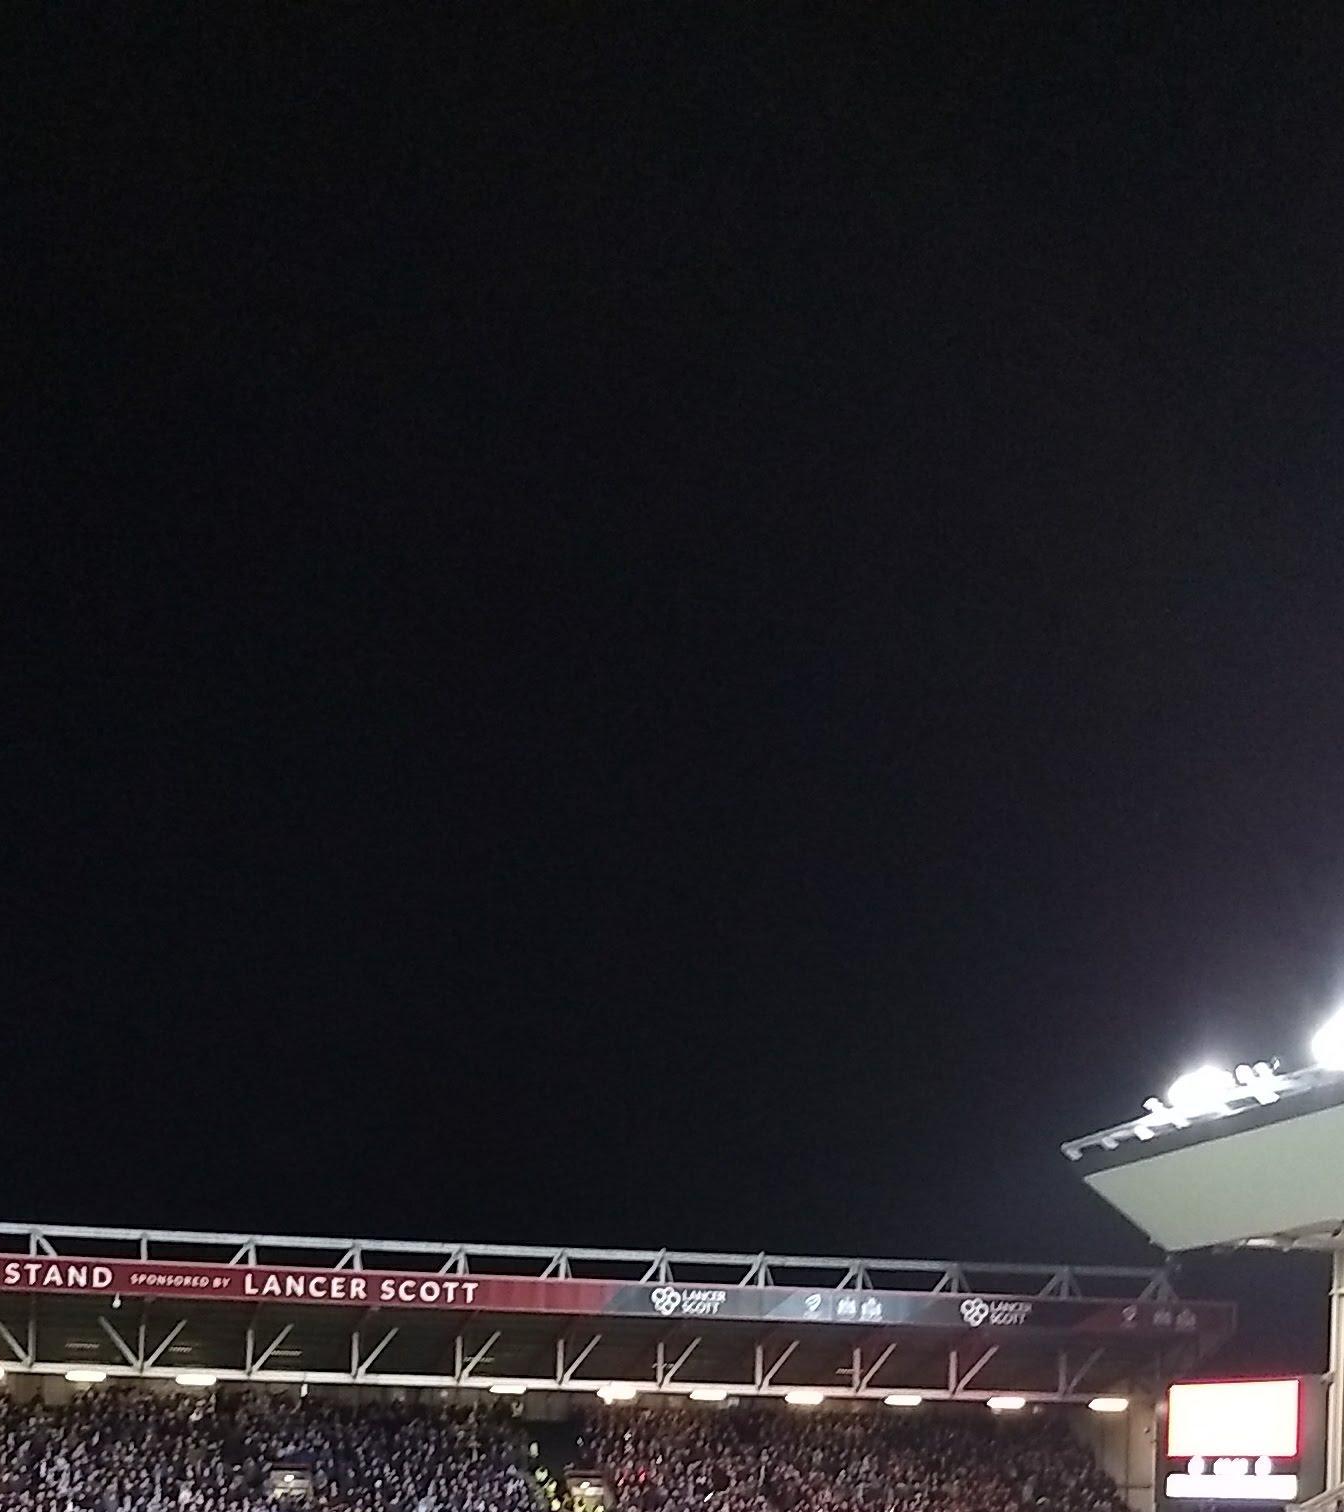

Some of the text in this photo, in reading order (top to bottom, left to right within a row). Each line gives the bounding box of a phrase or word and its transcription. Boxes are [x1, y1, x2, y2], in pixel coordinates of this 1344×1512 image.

[4, 1262, 114, 1289] STAND
[130, 1273, 210, 1288] SPONSORED
[212, 1276, 231, 1289] BY
[244, 1273, 368, 1300] LANCER
[379, 1279, 479, 1304] SCOTT
[682, 1301, 721, 1315] SCOTT
